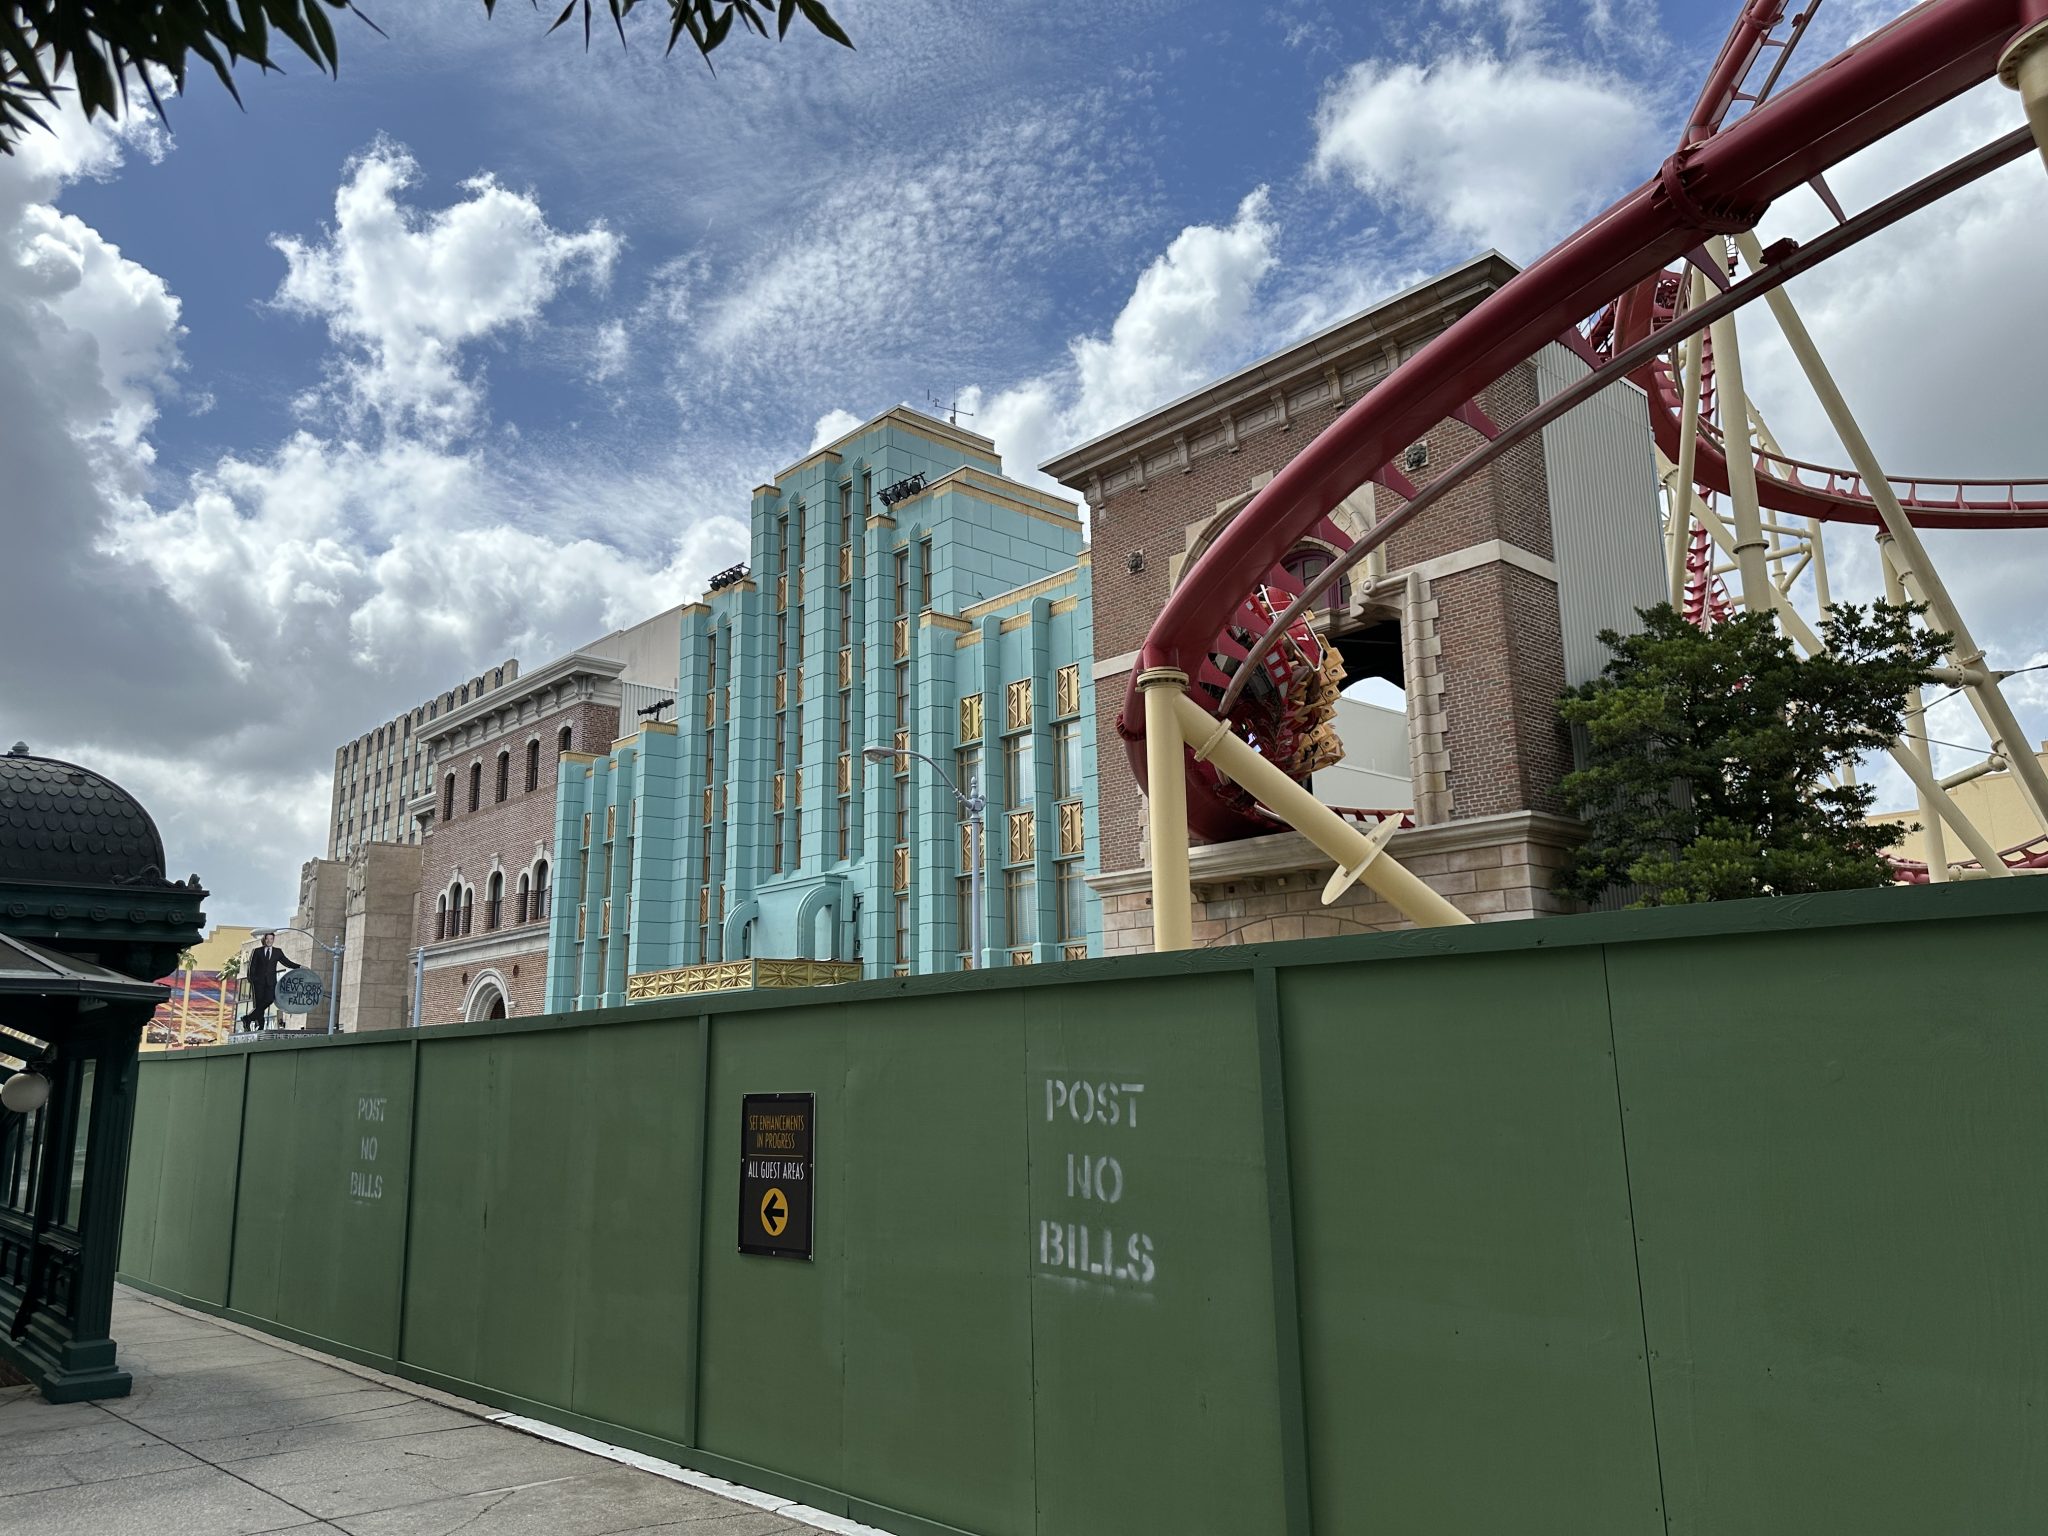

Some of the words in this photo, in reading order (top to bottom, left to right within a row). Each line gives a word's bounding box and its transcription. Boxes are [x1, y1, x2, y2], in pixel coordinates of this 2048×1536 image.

[280, 976, 304, 985] RACE
[280, 982, 299, 992] NEW
[301, 984, 322, 992] YORK
[288, 997, 319, 1006] FALLON
[358, 1097, 387, 1122] POST
[1046, 1079, 1145, 1128] POST
[750, 1115, 758, 1131] SET
[760, 1115, 804, 1131] ENHANCEMENTS
[361, 1136, 378, 1161] NO
[757, 1132, 764, 1149] IN
[765, 1132, 796, 1149] PROGRESS
[748, 1161, 759, 1178] ALL
[761, 1161, 780, 1179] GUEST
[783, 1162, 804, 1180] AREAS
[1067, 1153, 1123, 1204] NO
[350, 1171, 384, 1199] BILLS
[1040, 1220, 1155, 1283] BILLS
